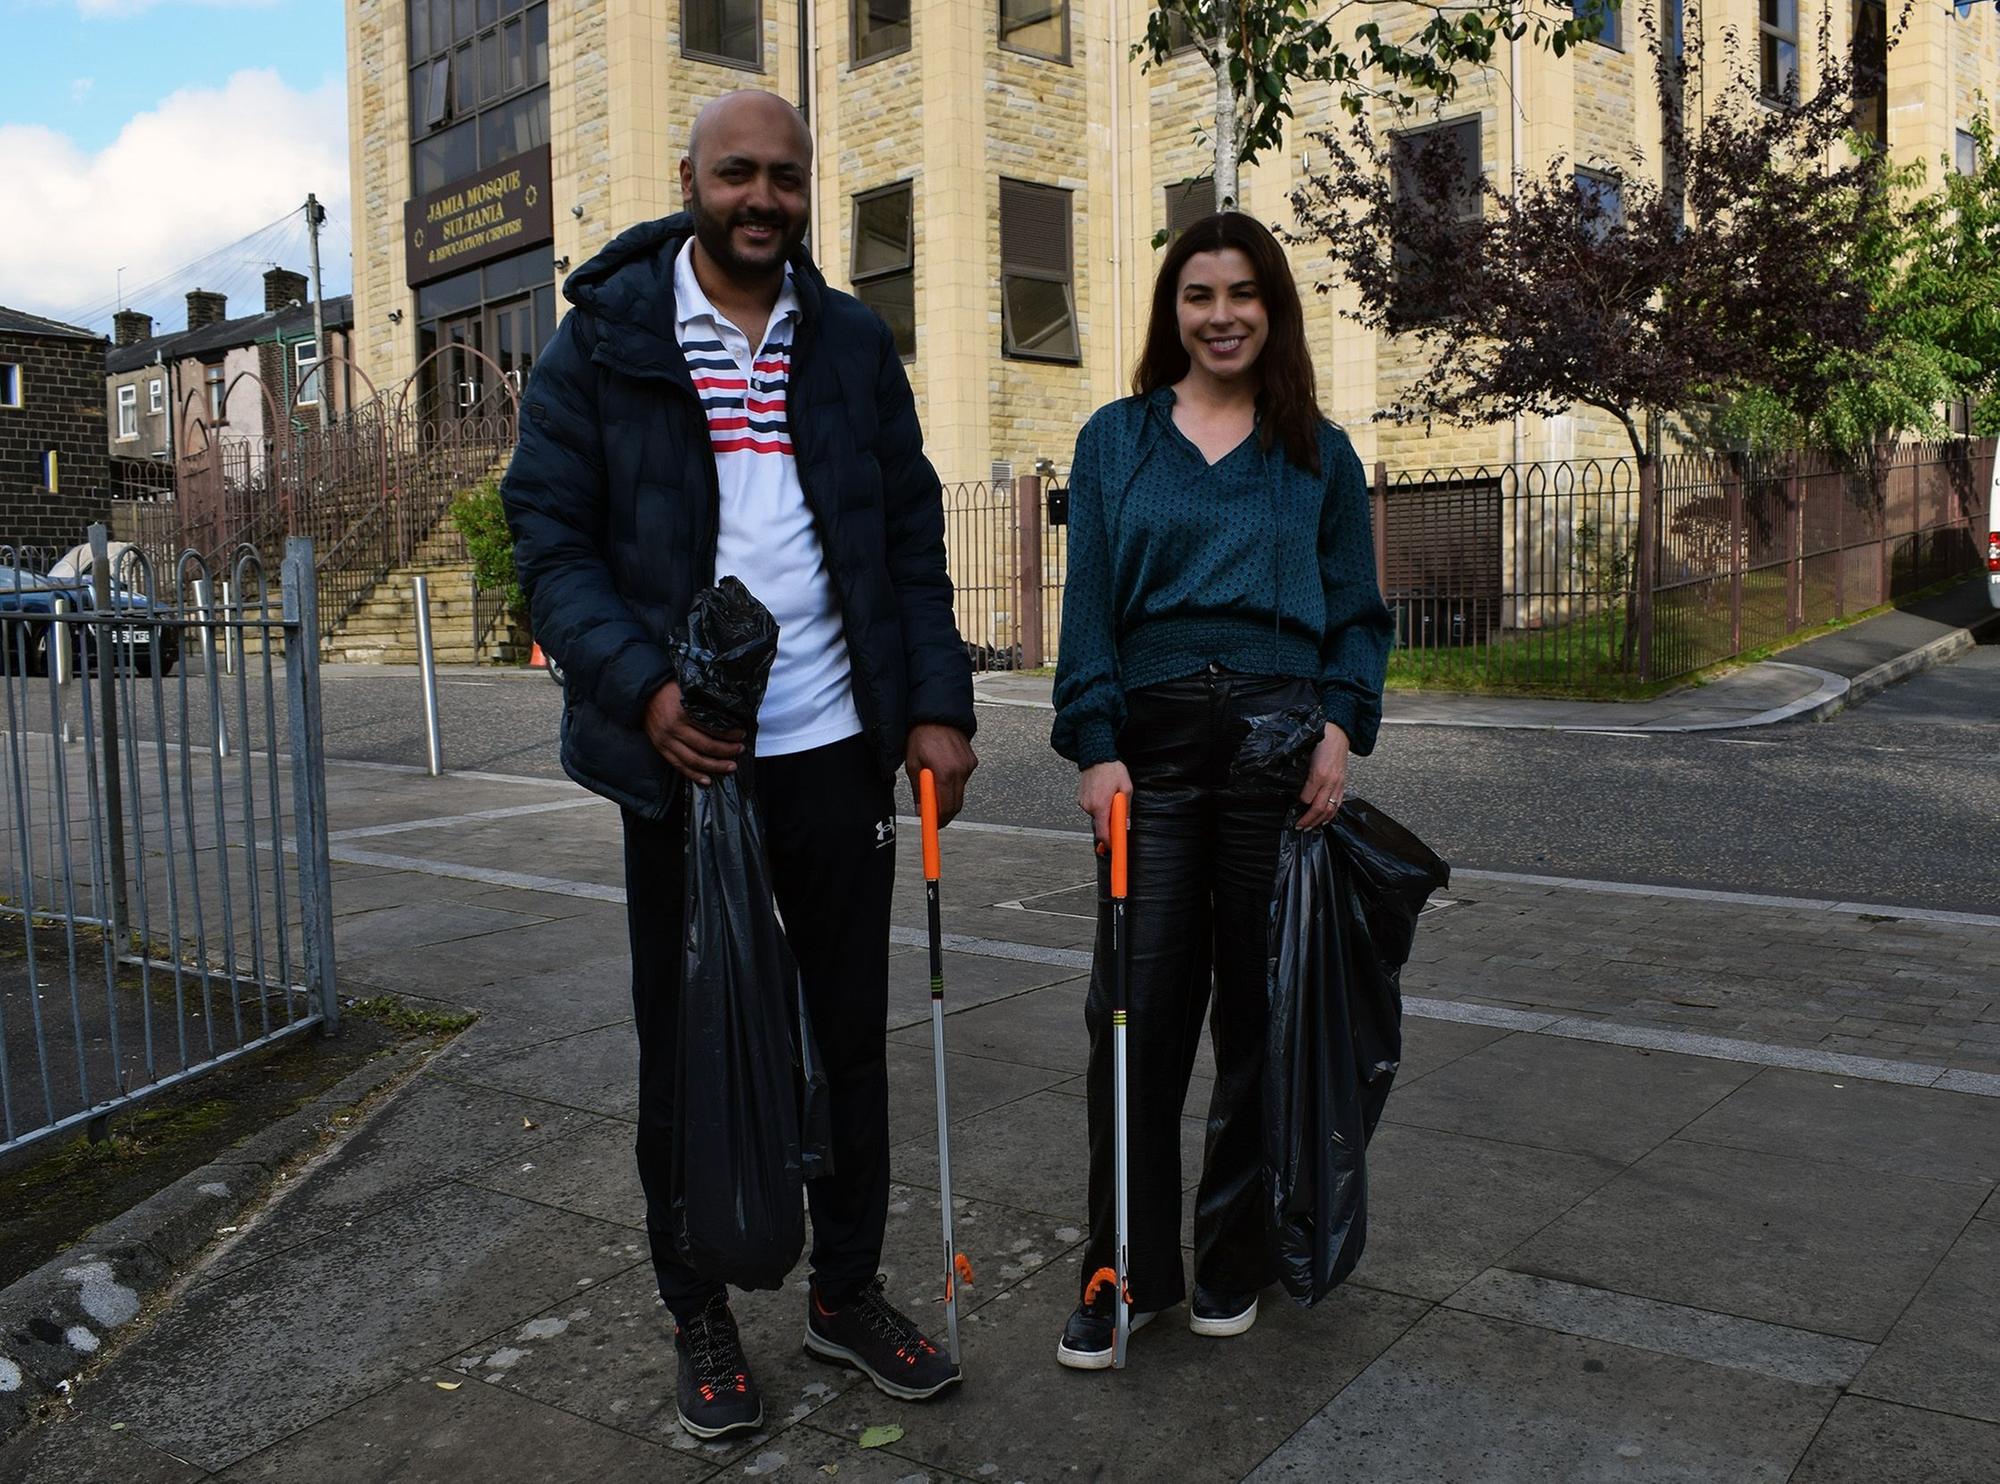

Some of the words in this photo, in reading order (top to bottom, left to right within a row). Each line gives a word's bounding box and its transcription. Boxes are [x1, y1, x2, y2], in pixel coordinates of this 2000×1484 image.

[427, 193, 465, 223] JAMIA
[466, 169, 521, 208] MOSQUE
[443, 201, 505, 240] SULTANIA
[428, 249, 436, 264] &
[436, 231, 487, 262] EDUCATION
